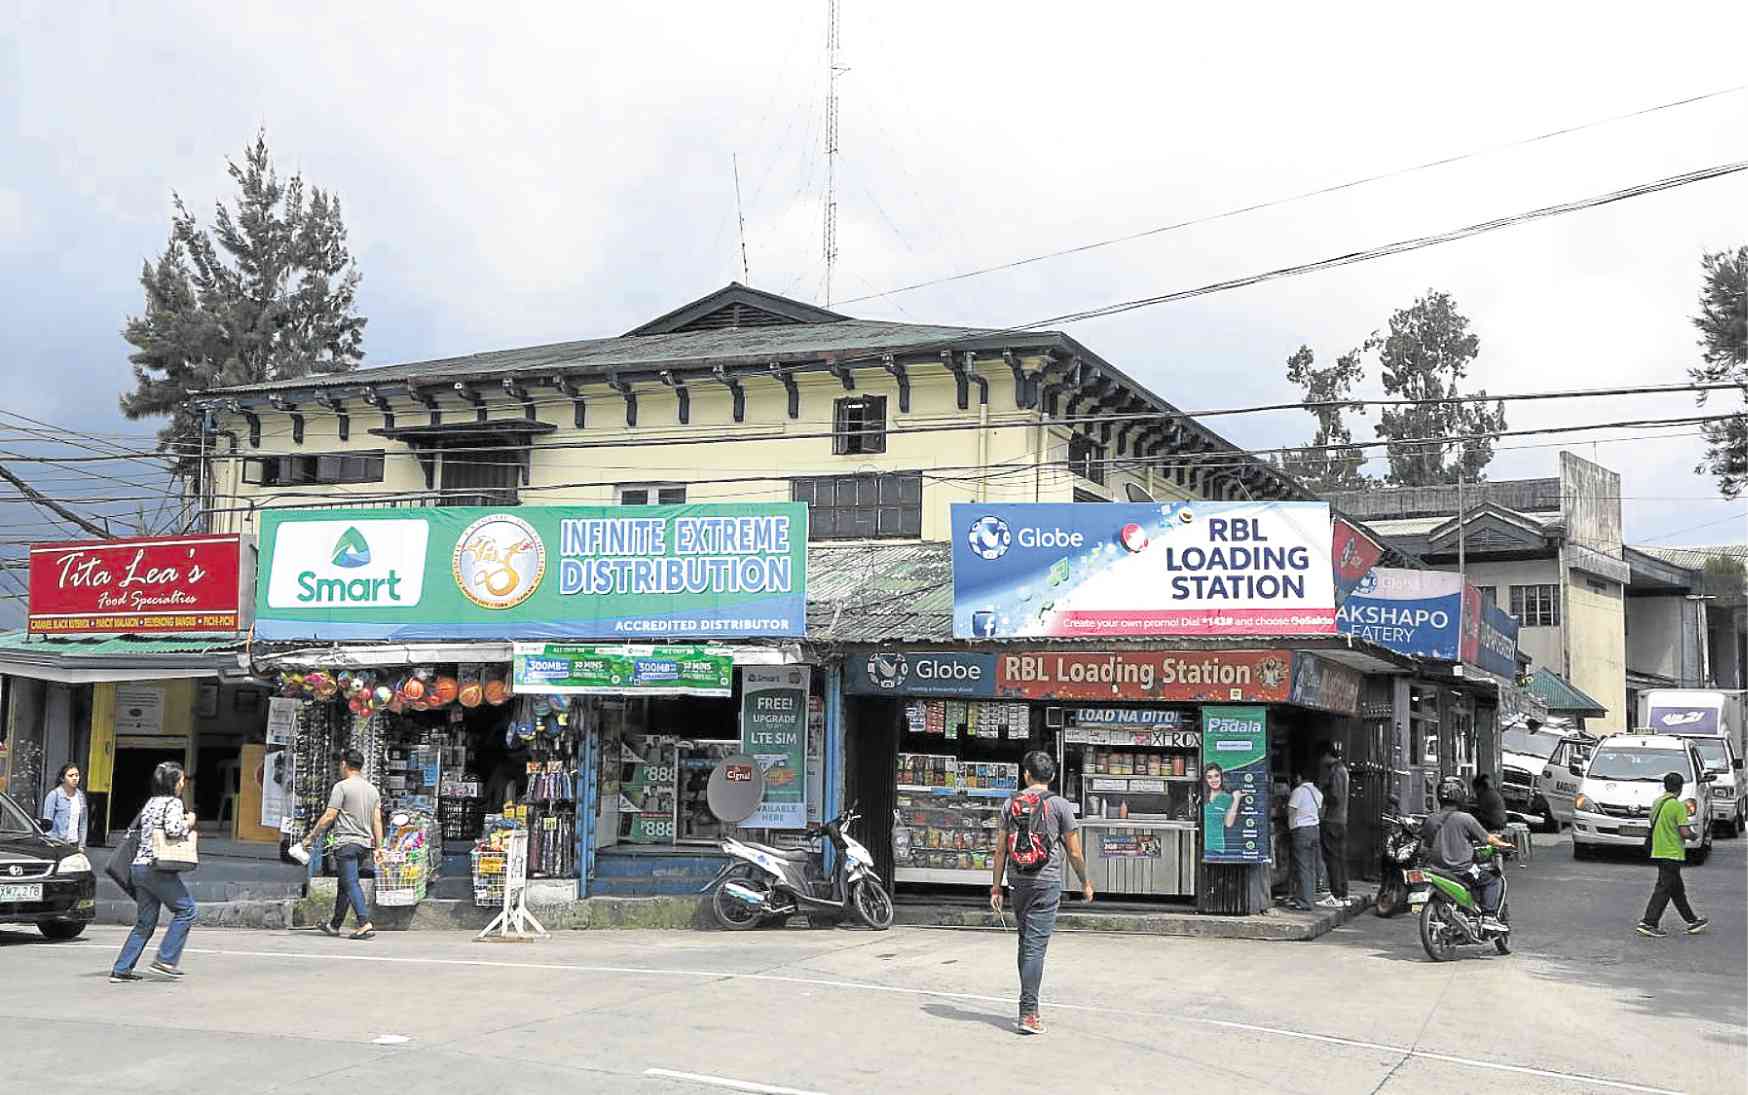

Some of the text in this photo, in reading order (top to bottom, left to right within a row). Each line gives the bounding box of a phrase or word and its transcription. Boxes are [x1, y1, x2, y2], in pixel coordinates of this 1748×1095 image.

[560, 516, 790, 556] INFINITE EXTREME
[1018, 528, 1084, 548] Globe
[1208, 518, 1268, 542] RBL
[56, 548, 206, 589] Tita Lea's
[1166, 546, 1310, 572] LOADING
[296, 569, 402, 602] Smart
[560, 556, 792, 595] DISTRIBUTION
[1171, 574, 1305, 600] STATION
[97, 591, 129, 609] Food
[614, 618, 789, 632] ACCREDITED DISTRIBUTOR
[1064, 619, 1096, 628] Create
[1097, 620, 1118, 630] your
[1120, 620, 1142, 628] own
[1235, 616, 1253, 626] and
[1255, 616, 1290, 626] choose
[1335, 605, 1449, 629] AKSHAPO
[1351, 625, 1416, 643] EATERY
[916, 660, 982, 680] Globe
[1004, 655, 1251, 690] RBL Loading Station
[757, 696, 794, 711] FREE!
[752, 714, 796, 724] UPGRADE
[1078, 708, 1115, 722] LOAD
[1117, 709, 1138, 723] NA
[751, 732, 798, 745] LTE SIM
[726, 769, 752, 782] Cignal
